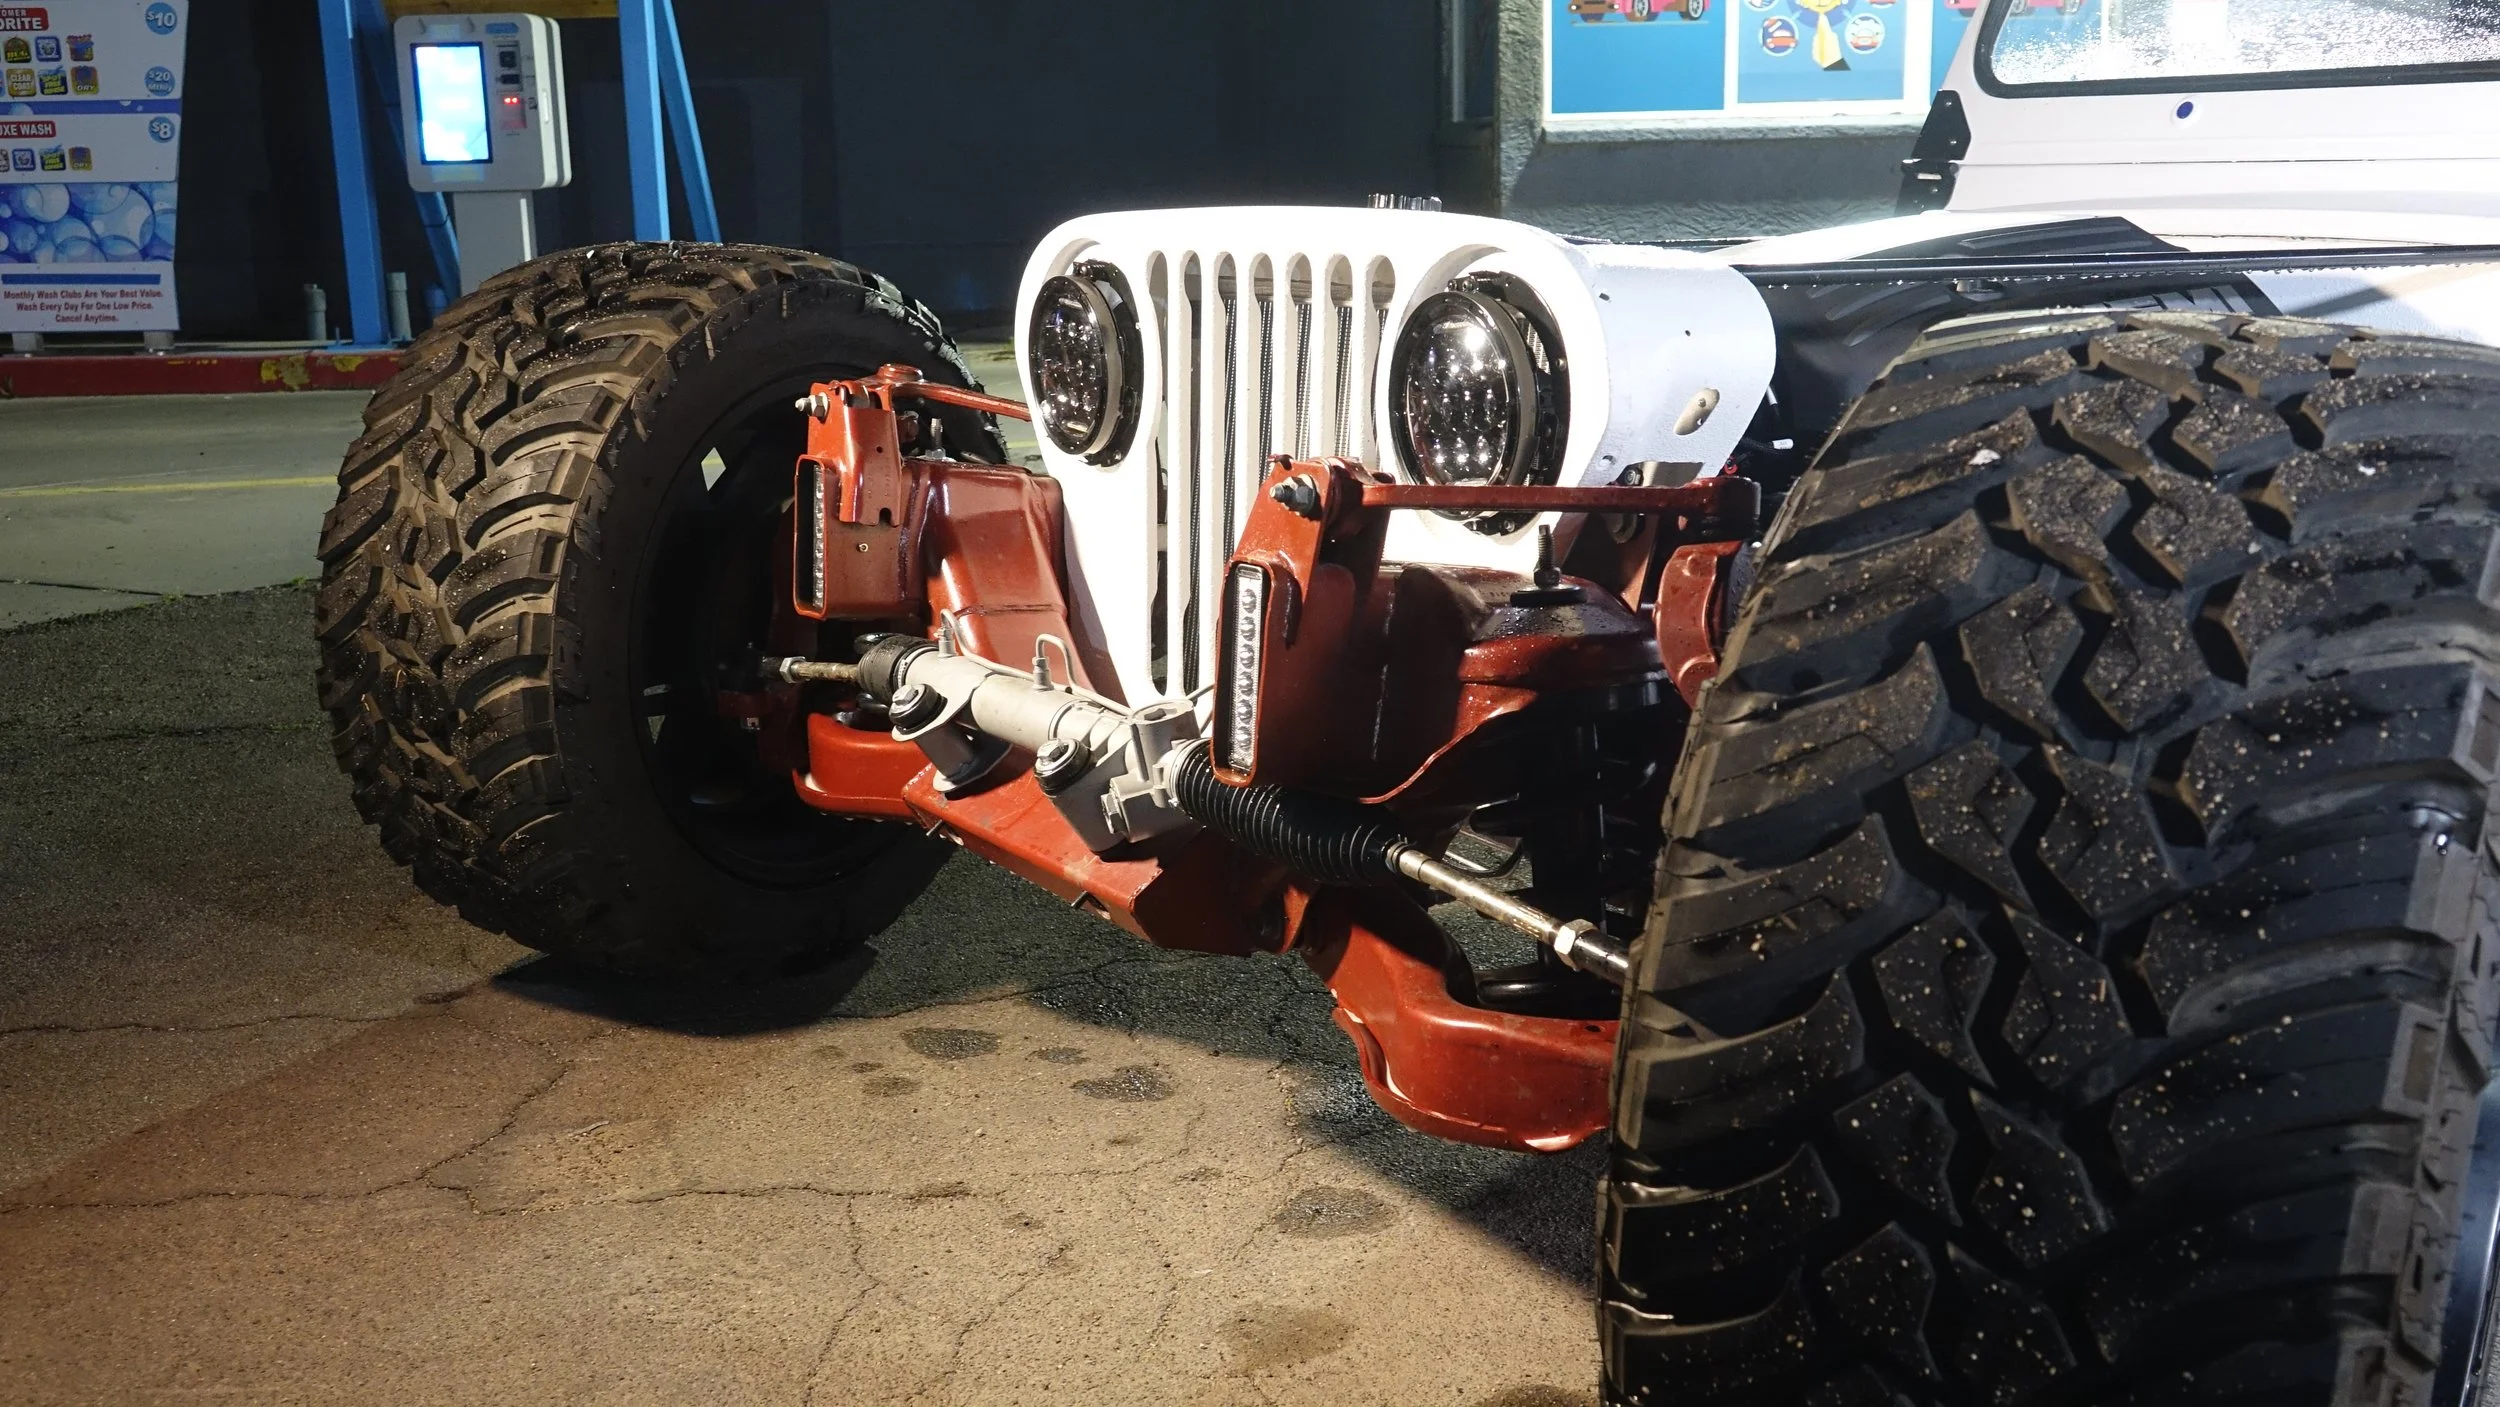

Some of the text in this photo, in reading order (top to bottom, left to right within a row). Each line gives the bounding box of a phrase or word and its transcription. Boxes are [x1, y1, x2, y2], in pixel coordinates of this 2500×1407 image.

[0, 9, 27, 17] OMER
[147, 11, 176, 27] $10
[148, 71, 171, 82] $20
[20, 123, 52, 135] WASH
[151, 121, 172, 139] $8
[4, 289, 163, 300] Monthly Wash Clubs Are Your Best Value.
[16, 301, 153, 312] Wash Every Day For One Low Price.
[55, 313, 119, 324] Cancel Anytime.
